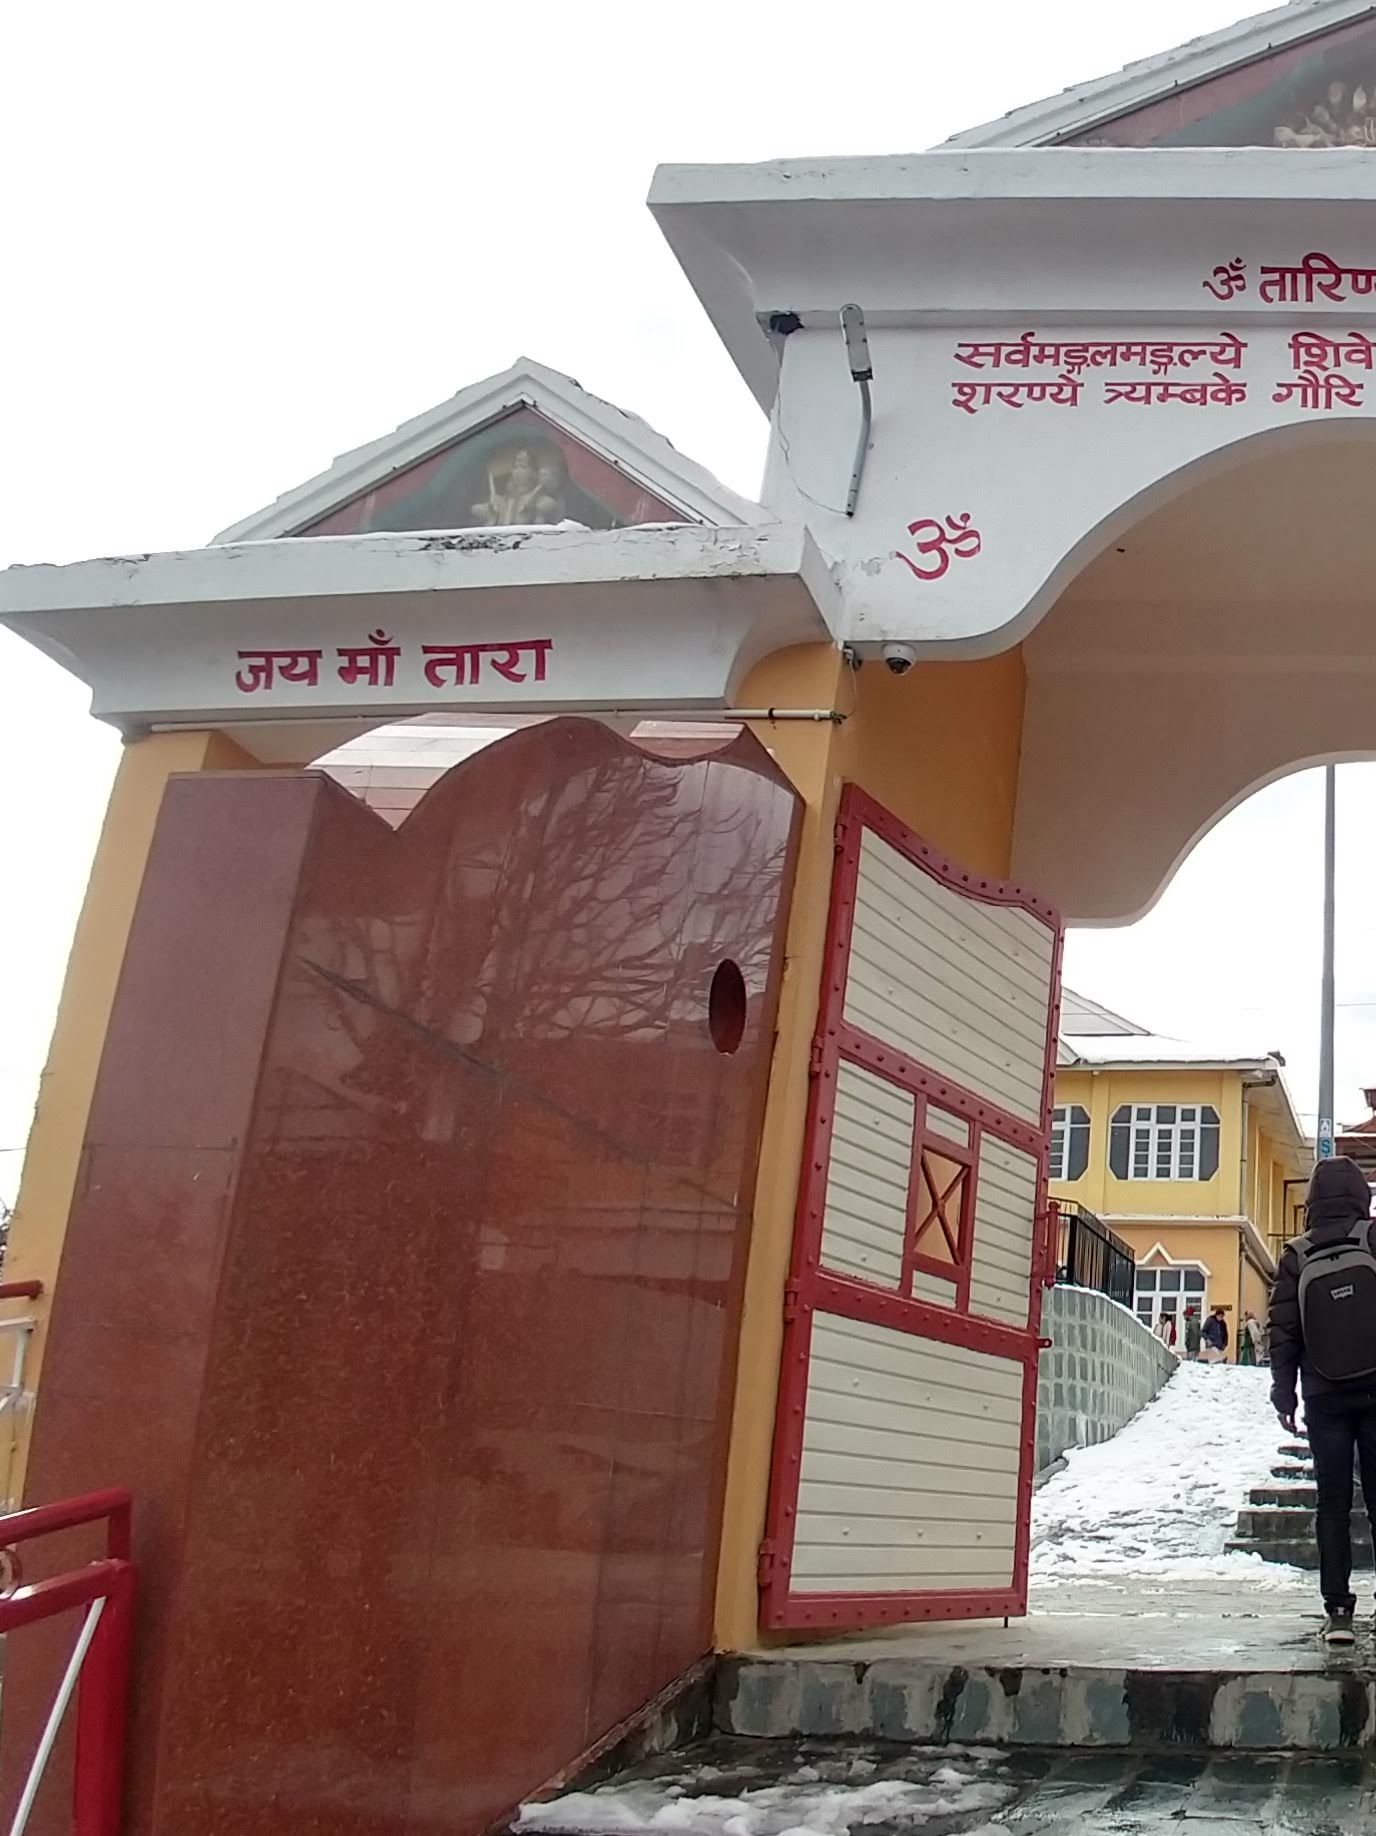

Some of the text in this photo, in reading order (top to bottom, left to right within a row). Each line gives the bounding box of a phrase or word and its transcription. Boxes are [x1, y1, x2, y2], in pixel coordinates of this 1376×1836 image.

[1202, 257, 1247, 303] ॐ
[951, 374, 1084, 413] शरण्ये
[1104, 372, 1247, 408] त्र्यम्बके
[1272, 370, 1365, 410] गौरि
[235, 629, 553, 693] जय माँ तारा
